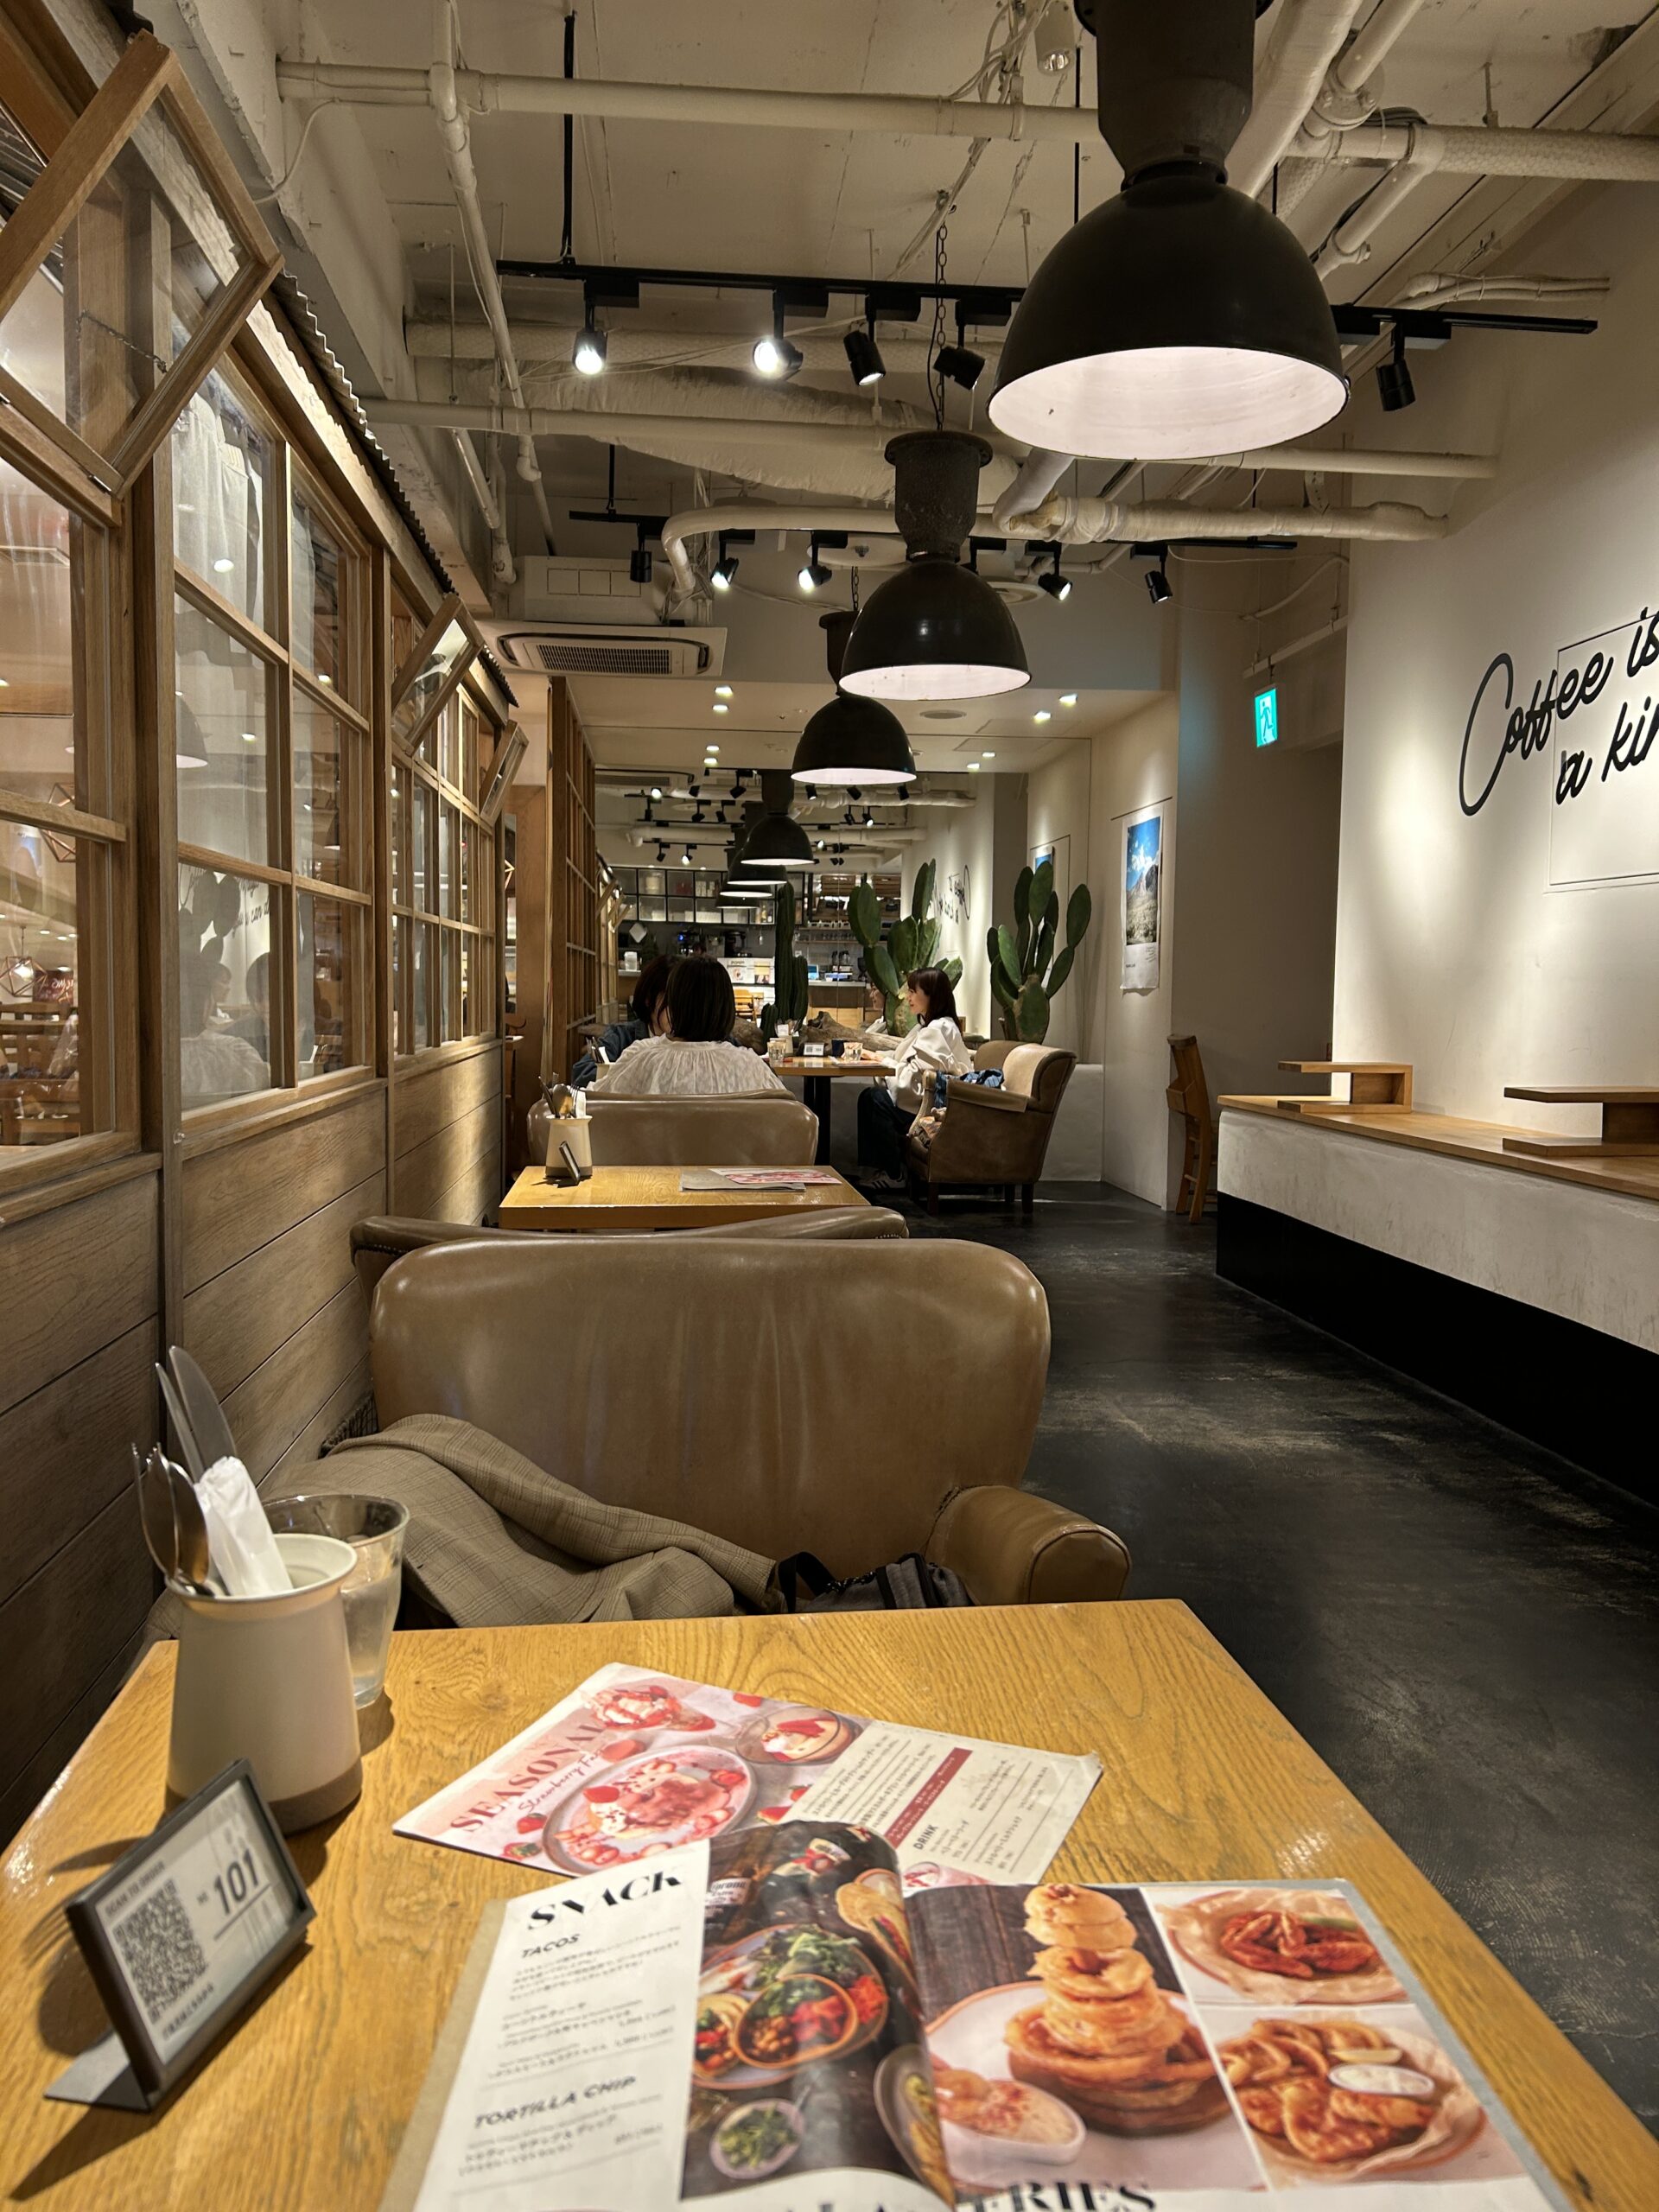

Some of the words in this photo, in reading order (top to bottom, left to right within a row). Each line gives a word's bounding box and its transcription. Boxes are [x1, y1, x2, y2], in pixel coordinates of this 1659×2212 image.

[1459, 652, 1614, 817] Coffee
[1556, 749, 1592, 804] a
[450, 1725, 604, 1833] SEASONAL
[518, 1765, 585, 1813] Strawberry
[912, 1824, 938, 1850] DRINK
[213, 1847, 259, 1916] 101
[527, 1866, 682, 1930] SNACK
[521, 1934, 581, 1959] TACOS
[474, 2091, 577, 2129] TORTILLA
[583, 2075, 636, 2099] CHIP
